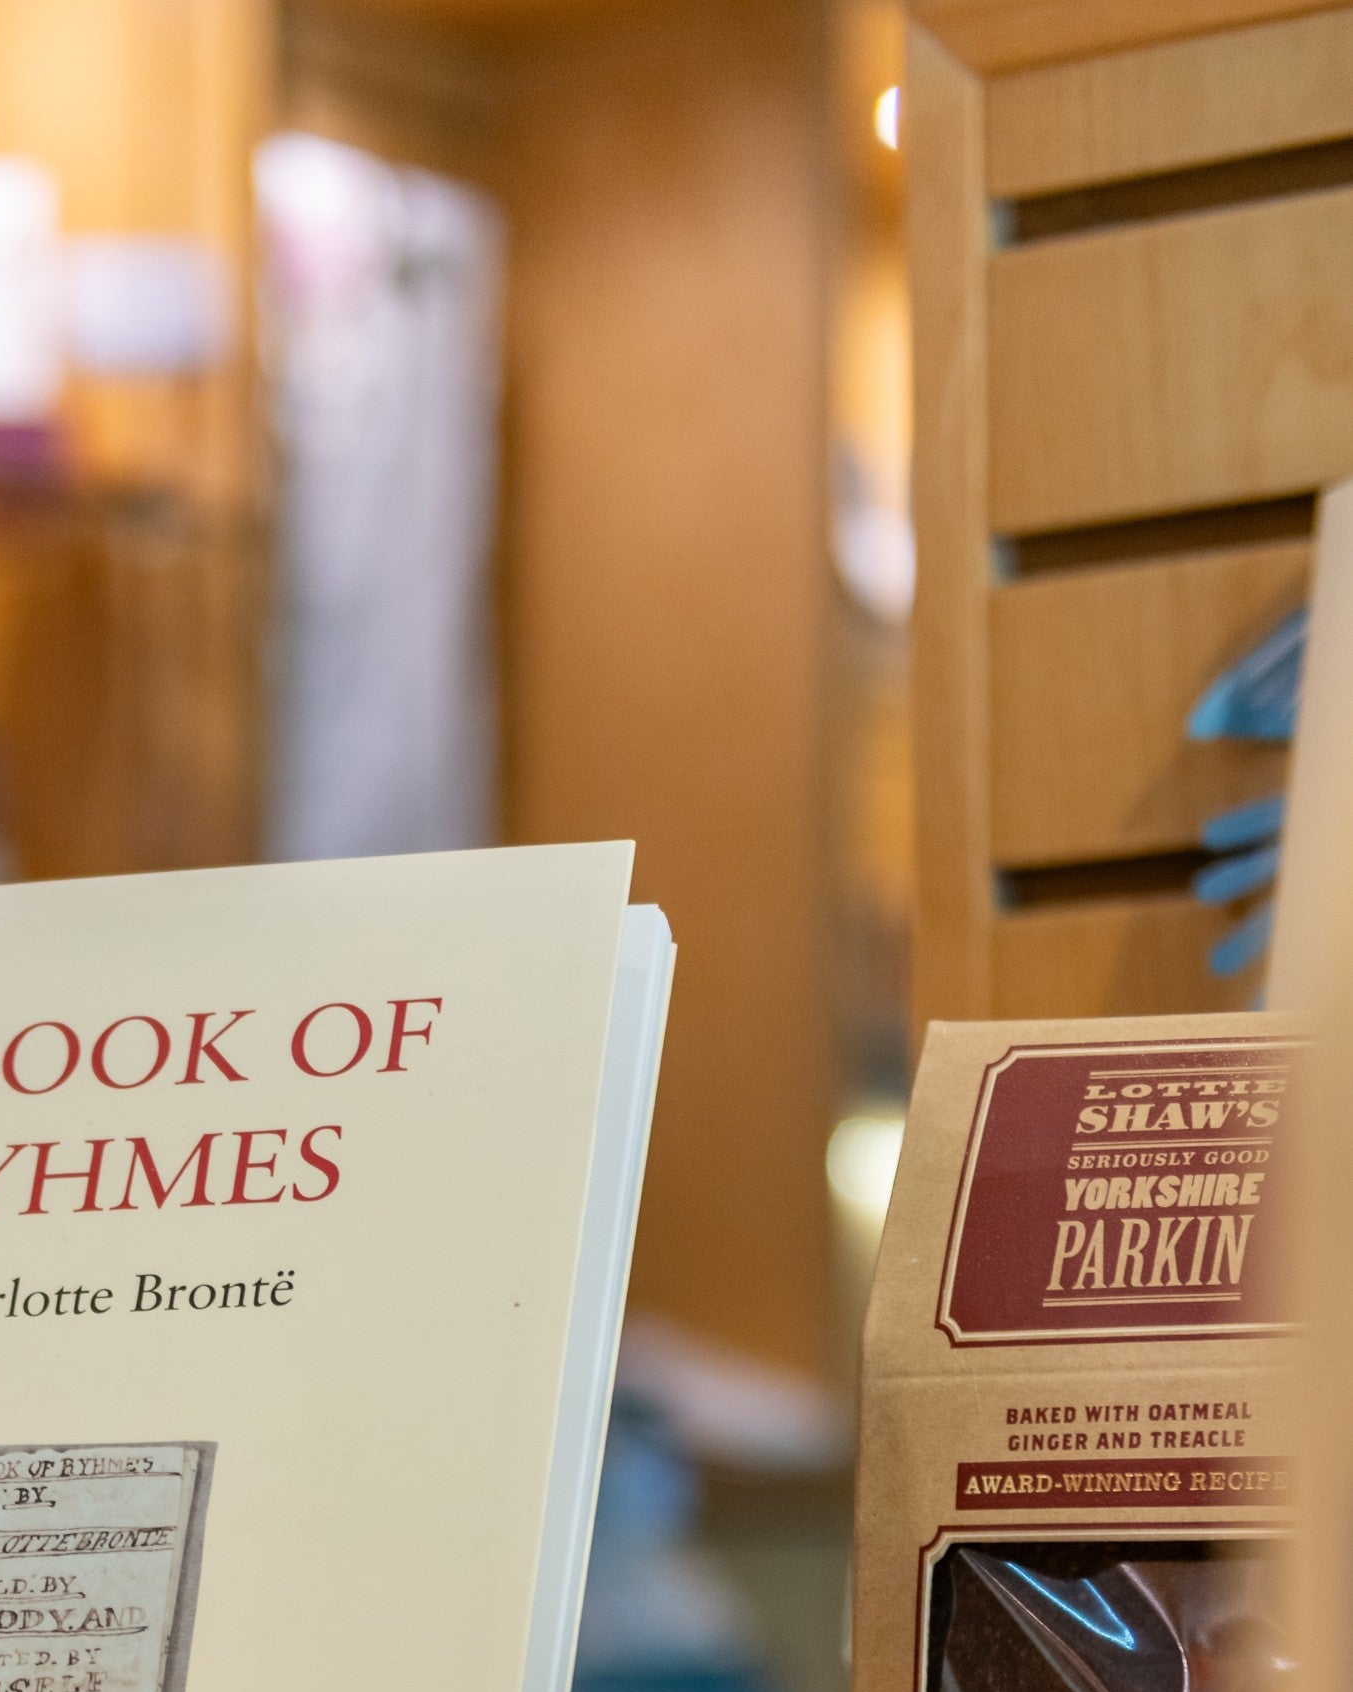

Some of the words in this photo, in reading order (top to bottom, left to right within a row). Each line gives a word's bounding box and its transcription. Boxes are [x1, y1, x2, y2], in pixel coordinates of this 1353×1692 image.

[290, 997, 443, 1078] OF
[1084, 1079, 1287, 1100] LOTTIE
[1075, 1100, 1280, 1134] SHAW'S
[1068, 1152, 1195, 1169] SERIOUSLY
[1203, 1149, 1270, 1165] GOOD
[1064, 1172, 1265, 1211] YORKSHIRE
[1046, 1214, 1256, 1291] PARKIN
[131, 1270, 295, 1312] Brontë
[1006, 1406, 1077, 1424] BAKED
[1085, 1405, 1138, 1422] WITH
[1148, 1402, 1251, 1420] OATMEAL
[1007, 1433, 1088, 1451] GINGER
[1096, 1431, 1141, 1449] AND
[1150, 1430, 1246, 1447] TREACLE
[28, 1461, 54, 1478] OF
[964, 1471, 1182, 1495] AWARD-WINNING
[1189, 1471, 1289, 1491] RECIPE
